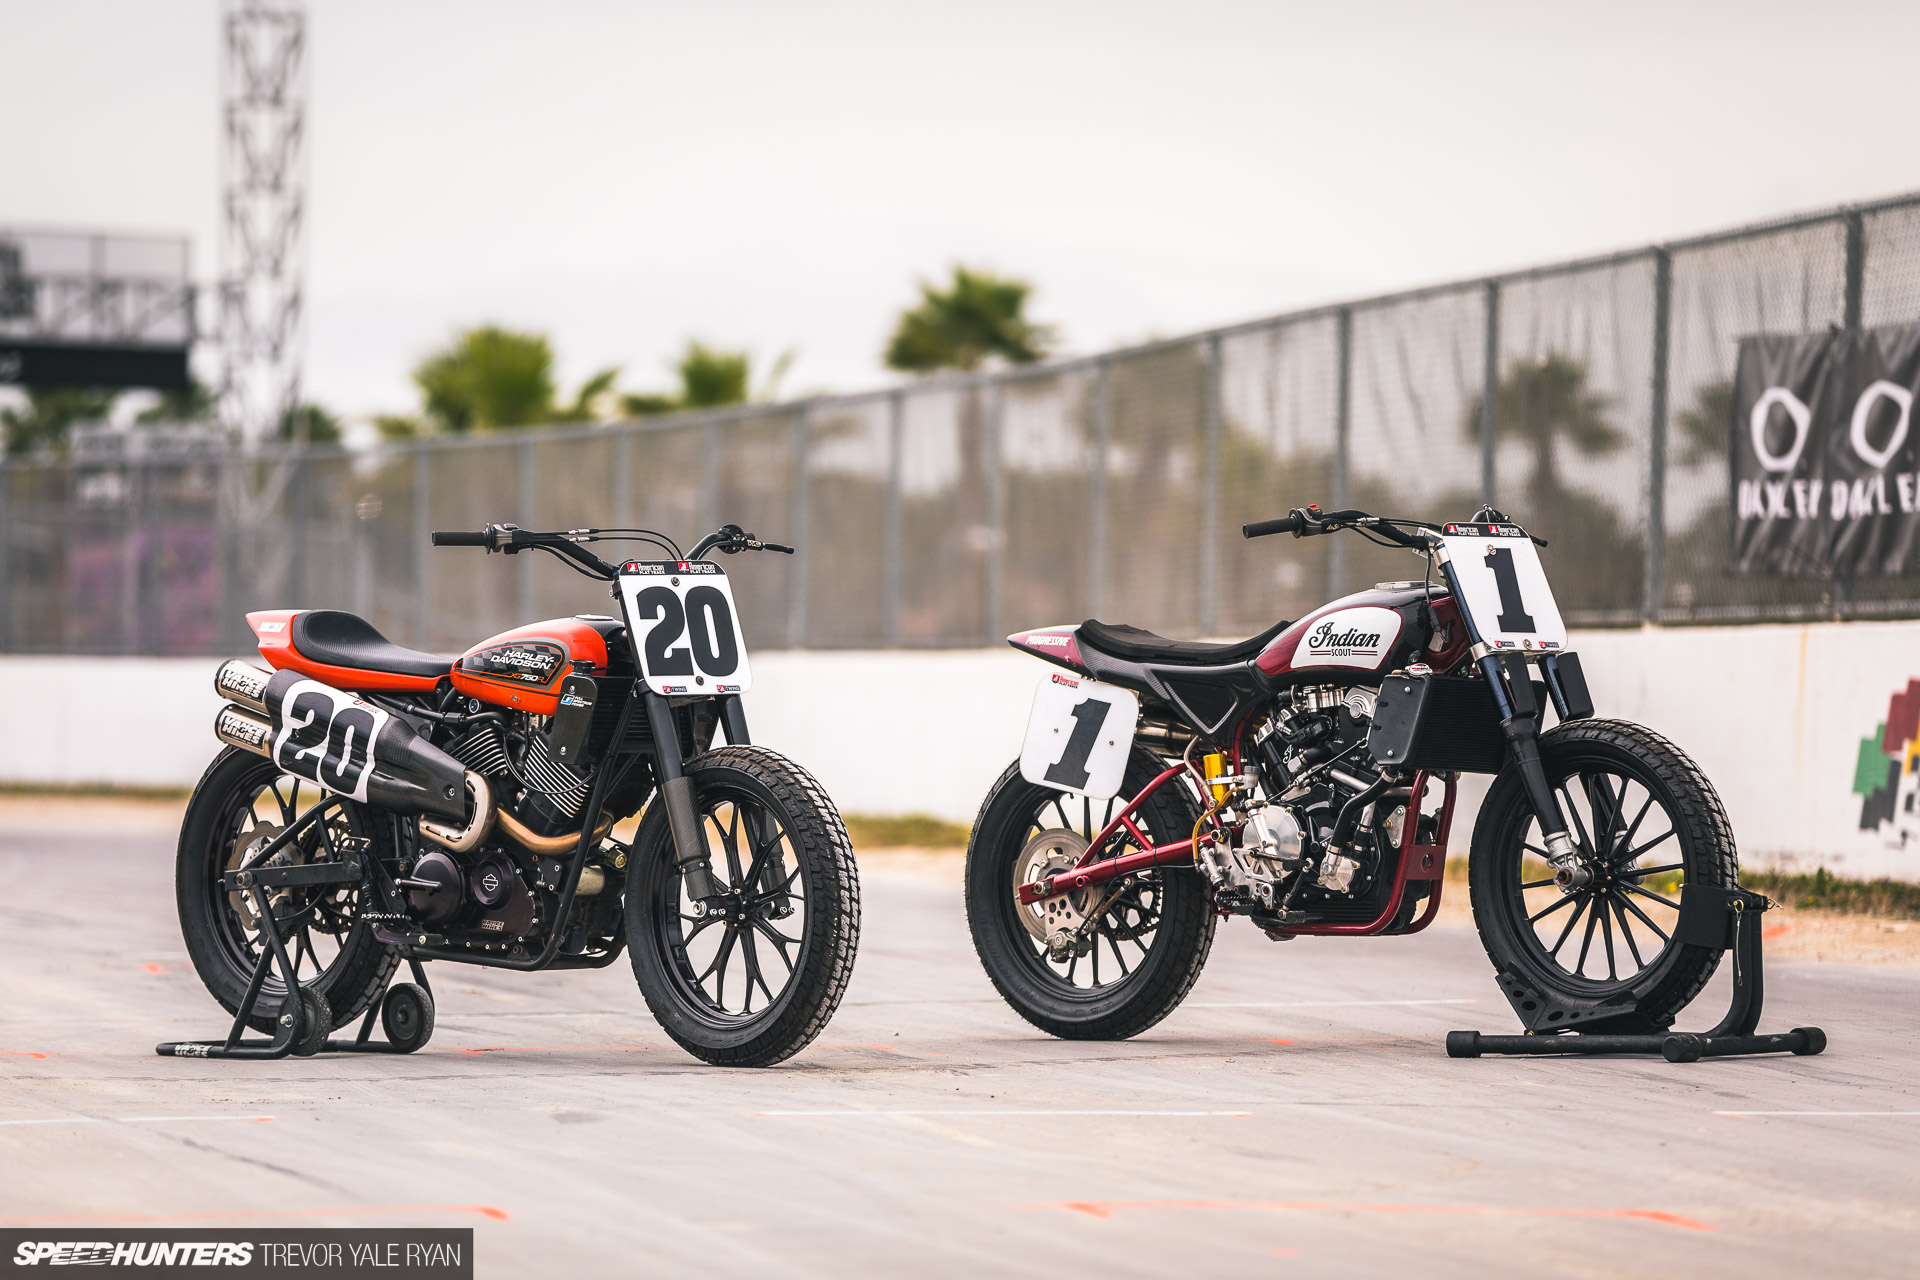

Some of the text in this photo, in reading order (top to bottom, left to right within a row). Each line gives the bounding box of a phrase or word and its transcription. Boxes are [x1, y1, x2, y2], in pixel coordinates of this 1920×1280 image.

[637, 562, 665, 571] American
[688, 562, 715, 571] American
[1484, 548, 1536, 633] 1
[636, 585, 738, 677] 20
[1025, 635, 1071, 647] PROGRESSIVE
[1308, 622, 1381, 648] Indian
[490, 655, 551, 670] DAVIDSON
[1331, 648, 1352, 657] SCOUT
[221, 677, 261, 698] HINES
[223, 669, 266, 690] VANCE
[221, 723, 261, 745] HINES
[223, 715, 266, 736] VANCE
[279, 692, 375, 794] 20
[1043, 698, 1111, 790] 1
